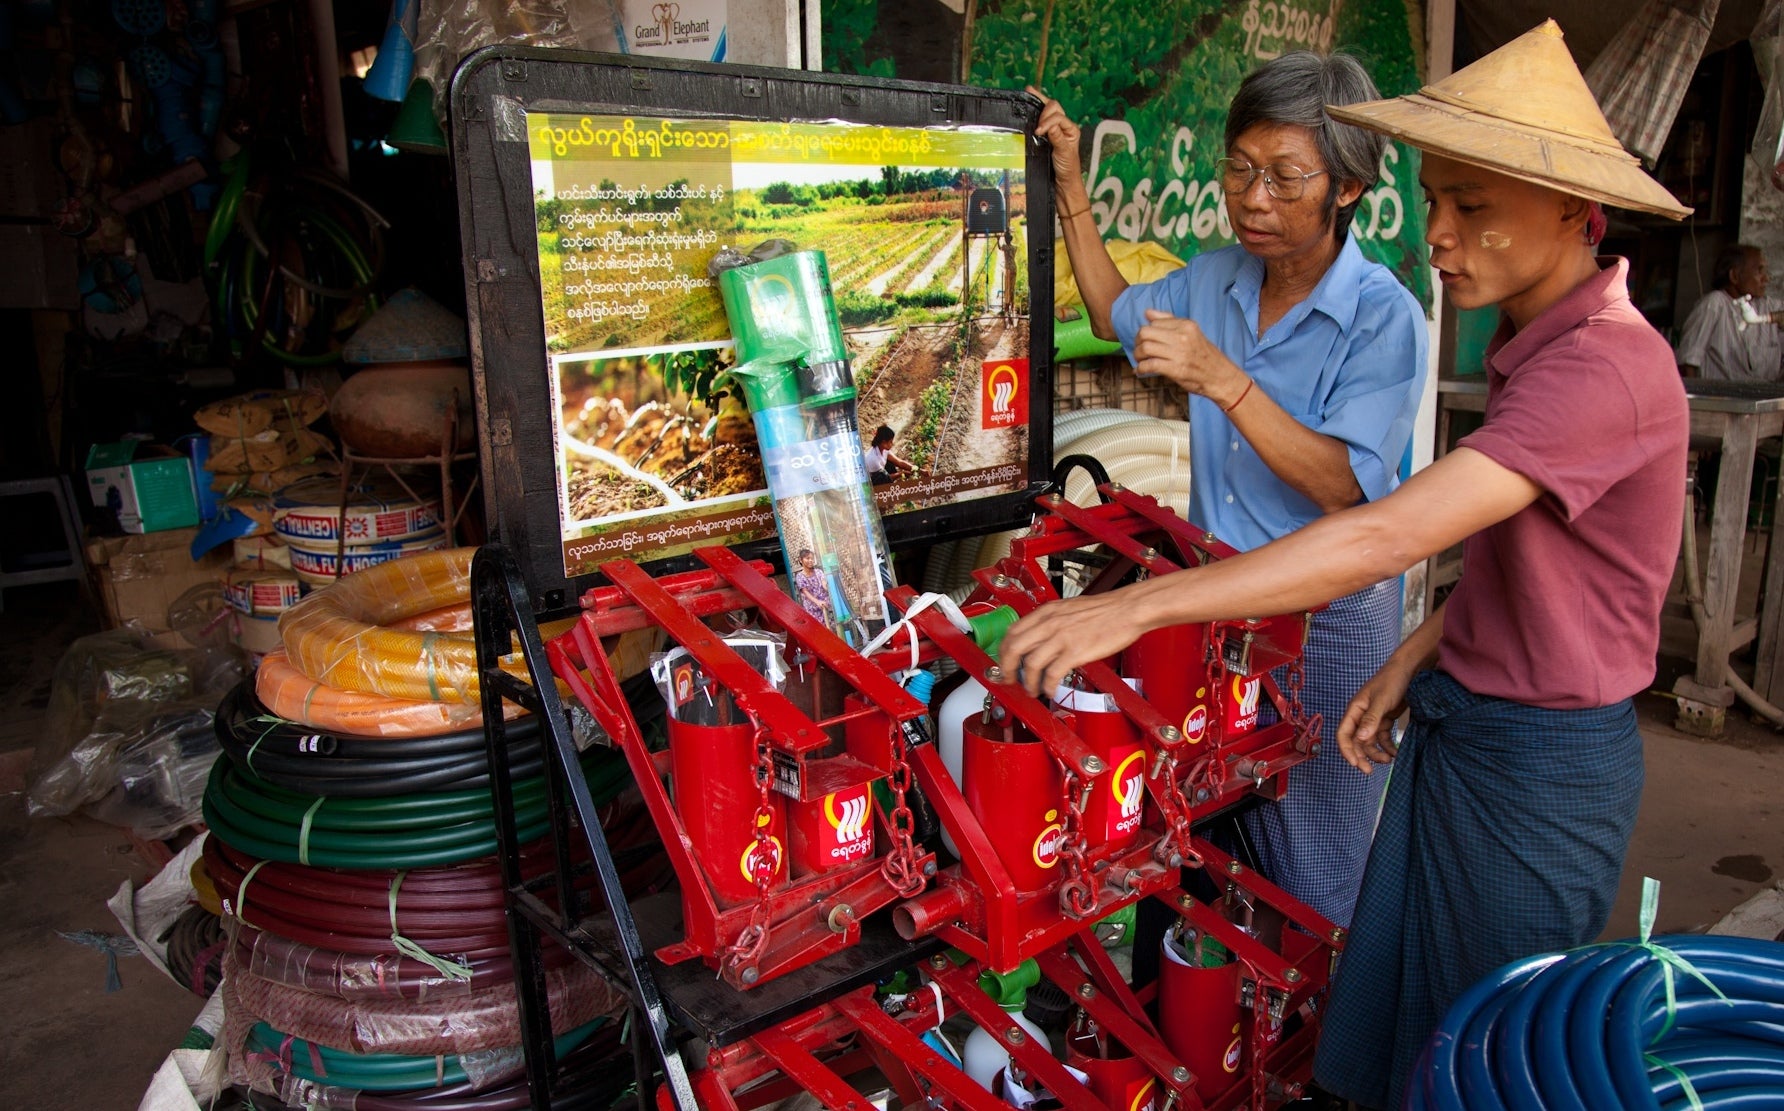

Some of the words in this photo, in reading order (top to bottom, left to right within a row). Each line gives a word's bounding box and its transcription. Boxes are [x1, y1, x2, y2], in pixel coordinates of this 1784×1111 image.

[635, 24, 660, 39] Grand
[673, 19, 710, 37] Elephant
[286, 516, 331, 537] CENTRAL
